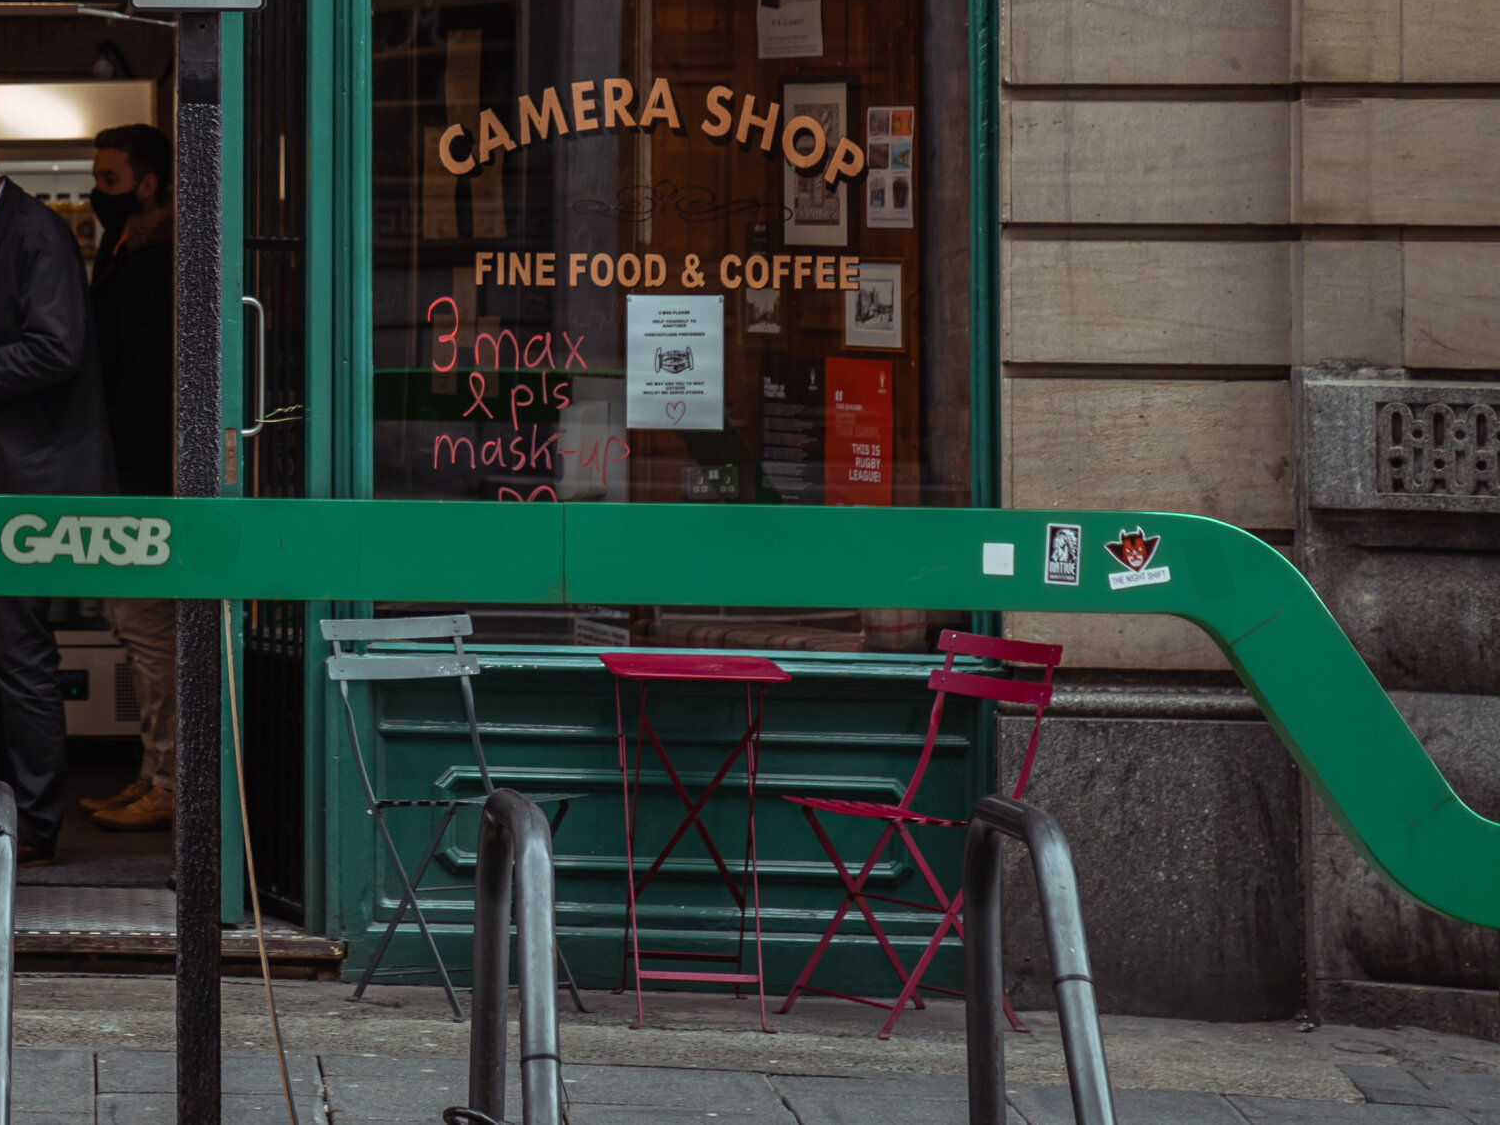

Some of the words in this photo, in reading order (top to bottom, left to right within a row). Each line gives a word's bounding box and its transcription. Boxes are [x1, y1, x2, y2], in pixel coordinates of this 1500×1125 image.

[438, 77, 682, 176] CAMERA
[700, 84, 866, 187] SHOP
[475, 251, 556, 287] FINE
[568, 251, 668, 288] FOOD
[681, 253, 706, 288] &
[720, 253, 861, 290] COFFEE
[426, 295, 460, 374] 3
[474, 329, 590, 372] max
[509, 373, 572, 431] pls
[432, 422, 632, 488] mask-up
[852, 442, 870, 455] THIS
[871, 443, 881, 456] IS
[855, 456, 881, 469] RUGBY
[848, 468, 881, 483] LEAGUE!
